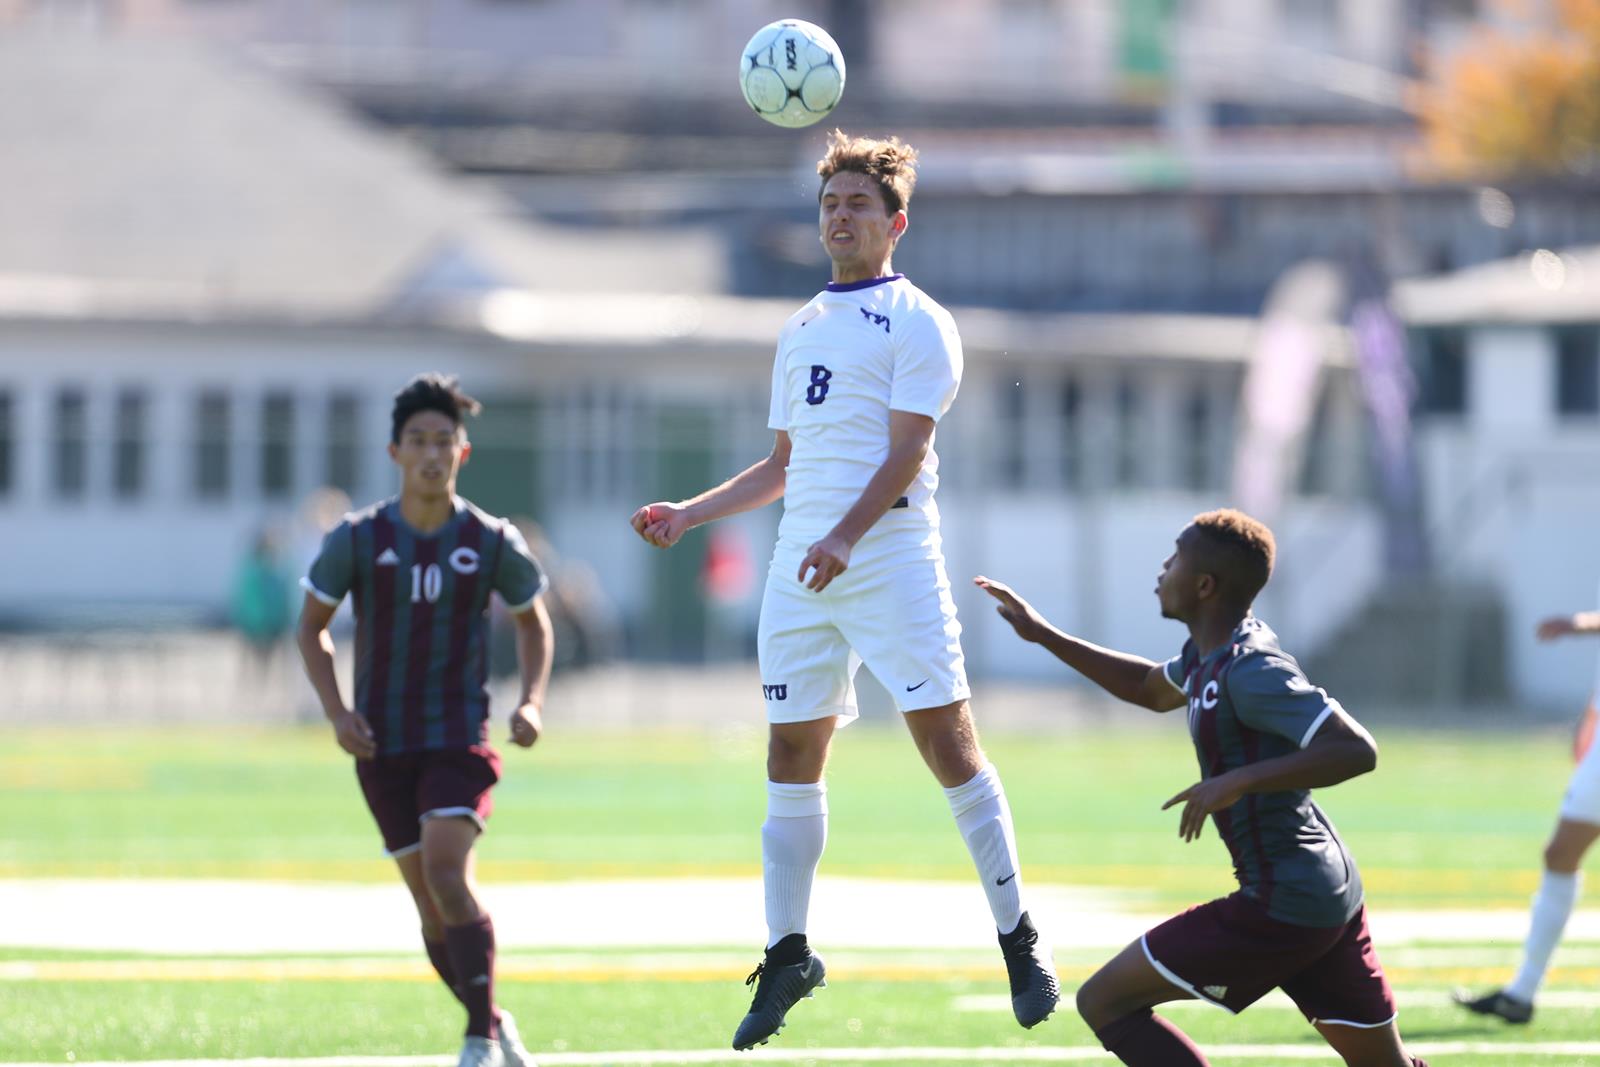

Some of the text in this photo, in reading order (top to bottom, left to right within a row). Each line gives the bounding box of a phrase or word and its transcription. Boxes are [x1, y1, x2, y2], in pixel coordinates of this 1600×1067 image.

[806, 364, 832, 406] 8
[448, 546, 480, 575] C
[411, 562, 443, 604] 10
[1202, 679, 1219, 710] C
